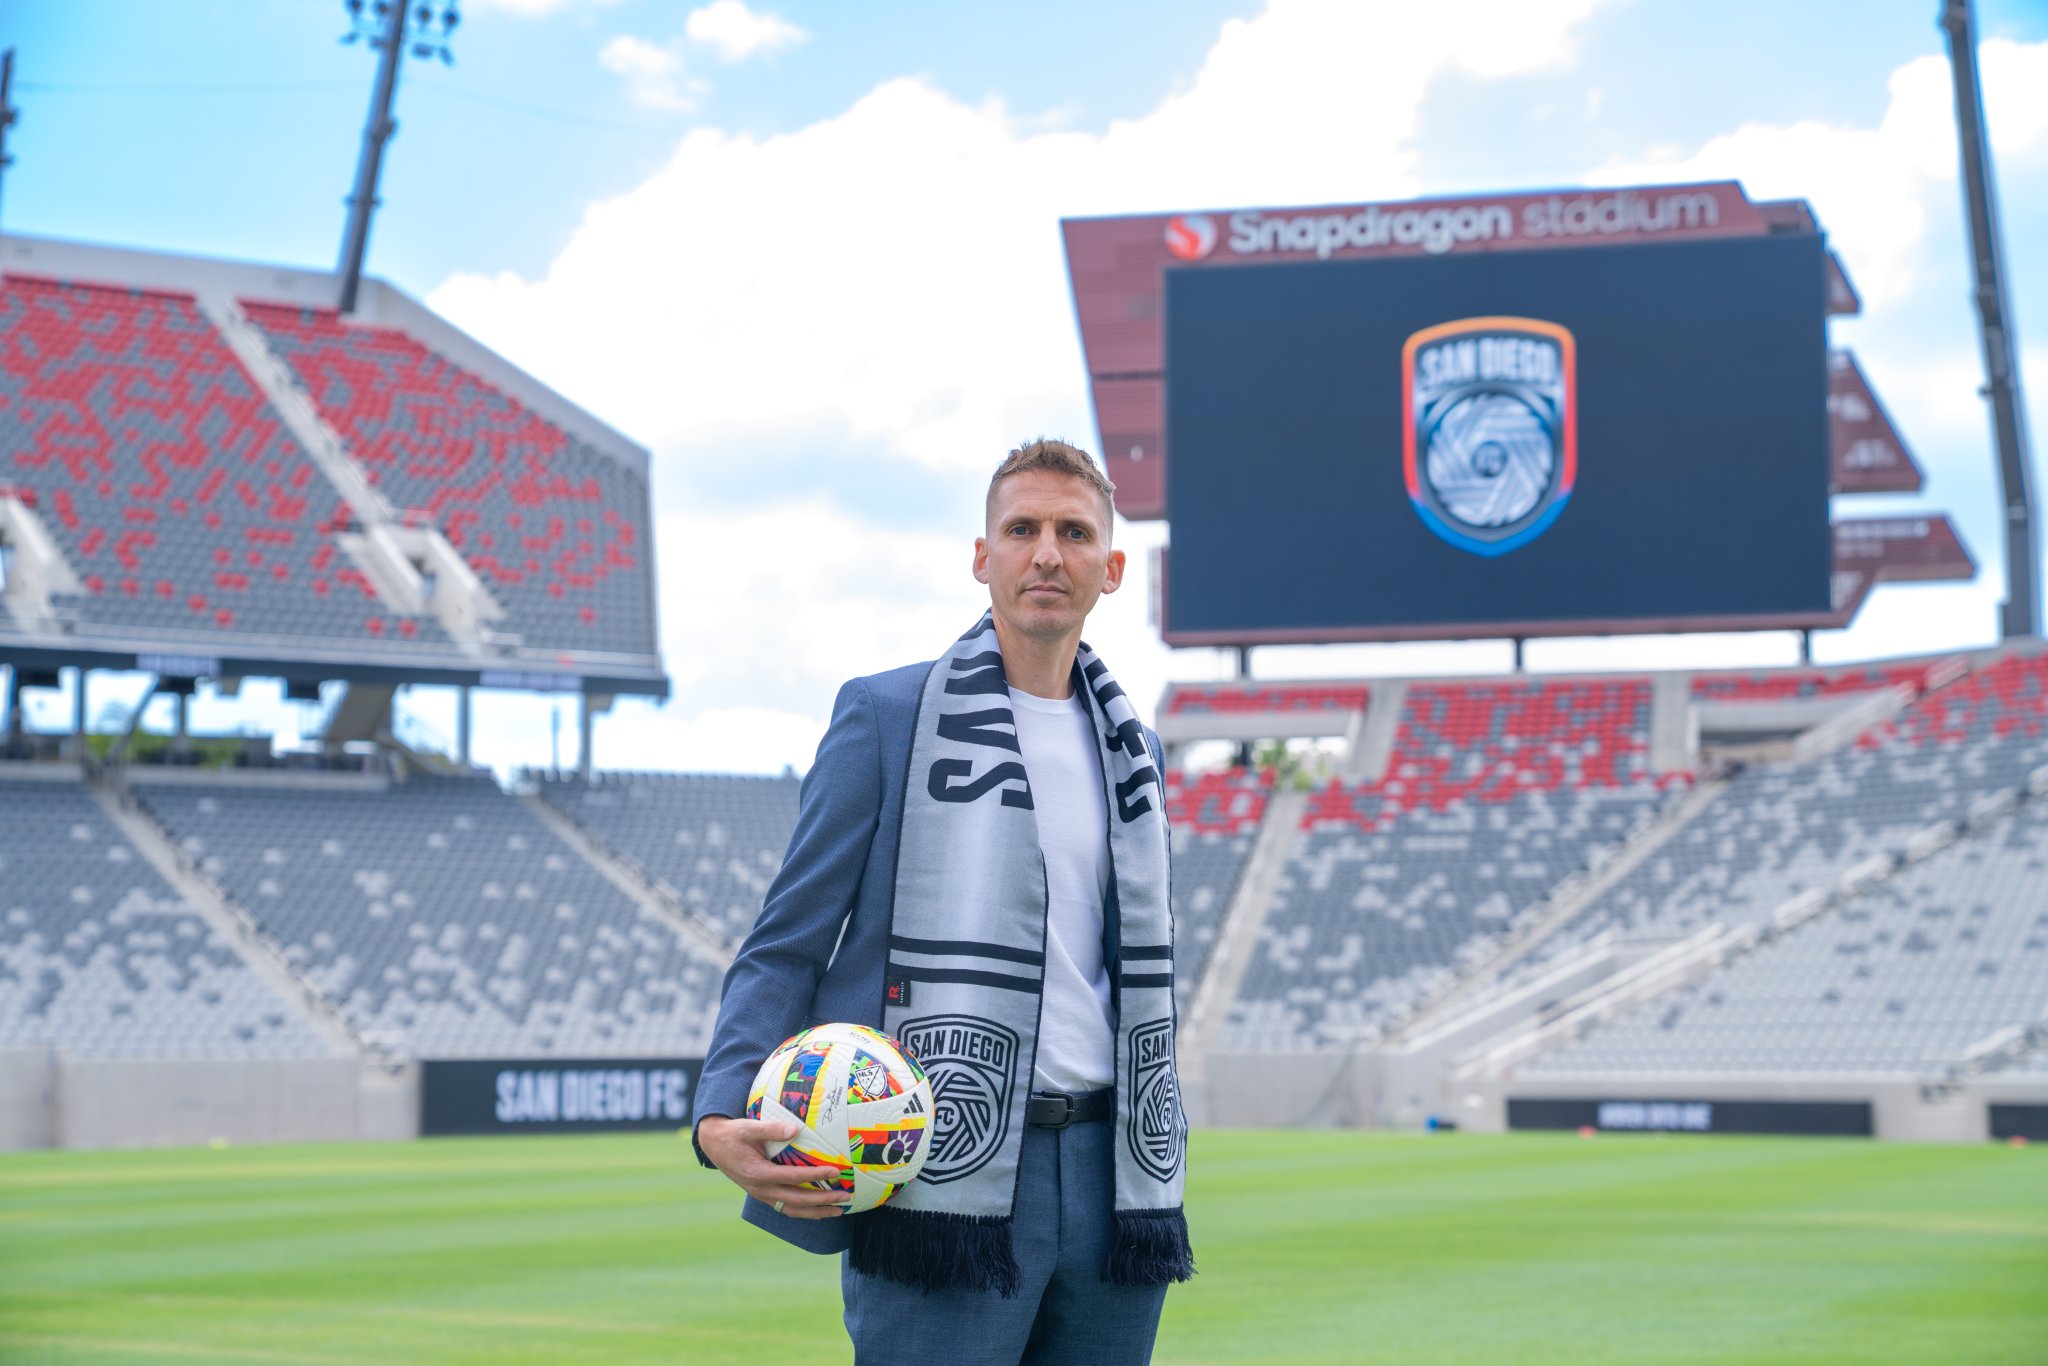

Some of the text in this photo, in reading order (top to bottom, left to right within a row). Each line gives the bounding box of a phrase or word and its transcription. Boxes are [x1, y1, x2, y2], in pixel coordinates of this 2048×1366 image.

[1229, 191, 1719, 260] Snapdragon stadium
[1421, 338, 1556, 386] SAN DIEGO
[910, 1029, 1005, 1067] SAN DIEGO
[1141, 1032, 1168, 1064] SAN
[858, 1070, 873, 1078] MLS
[496, 1069, 688, 1122] SAN DIEGO FC
[935, 1106, 955, 1126] FC
